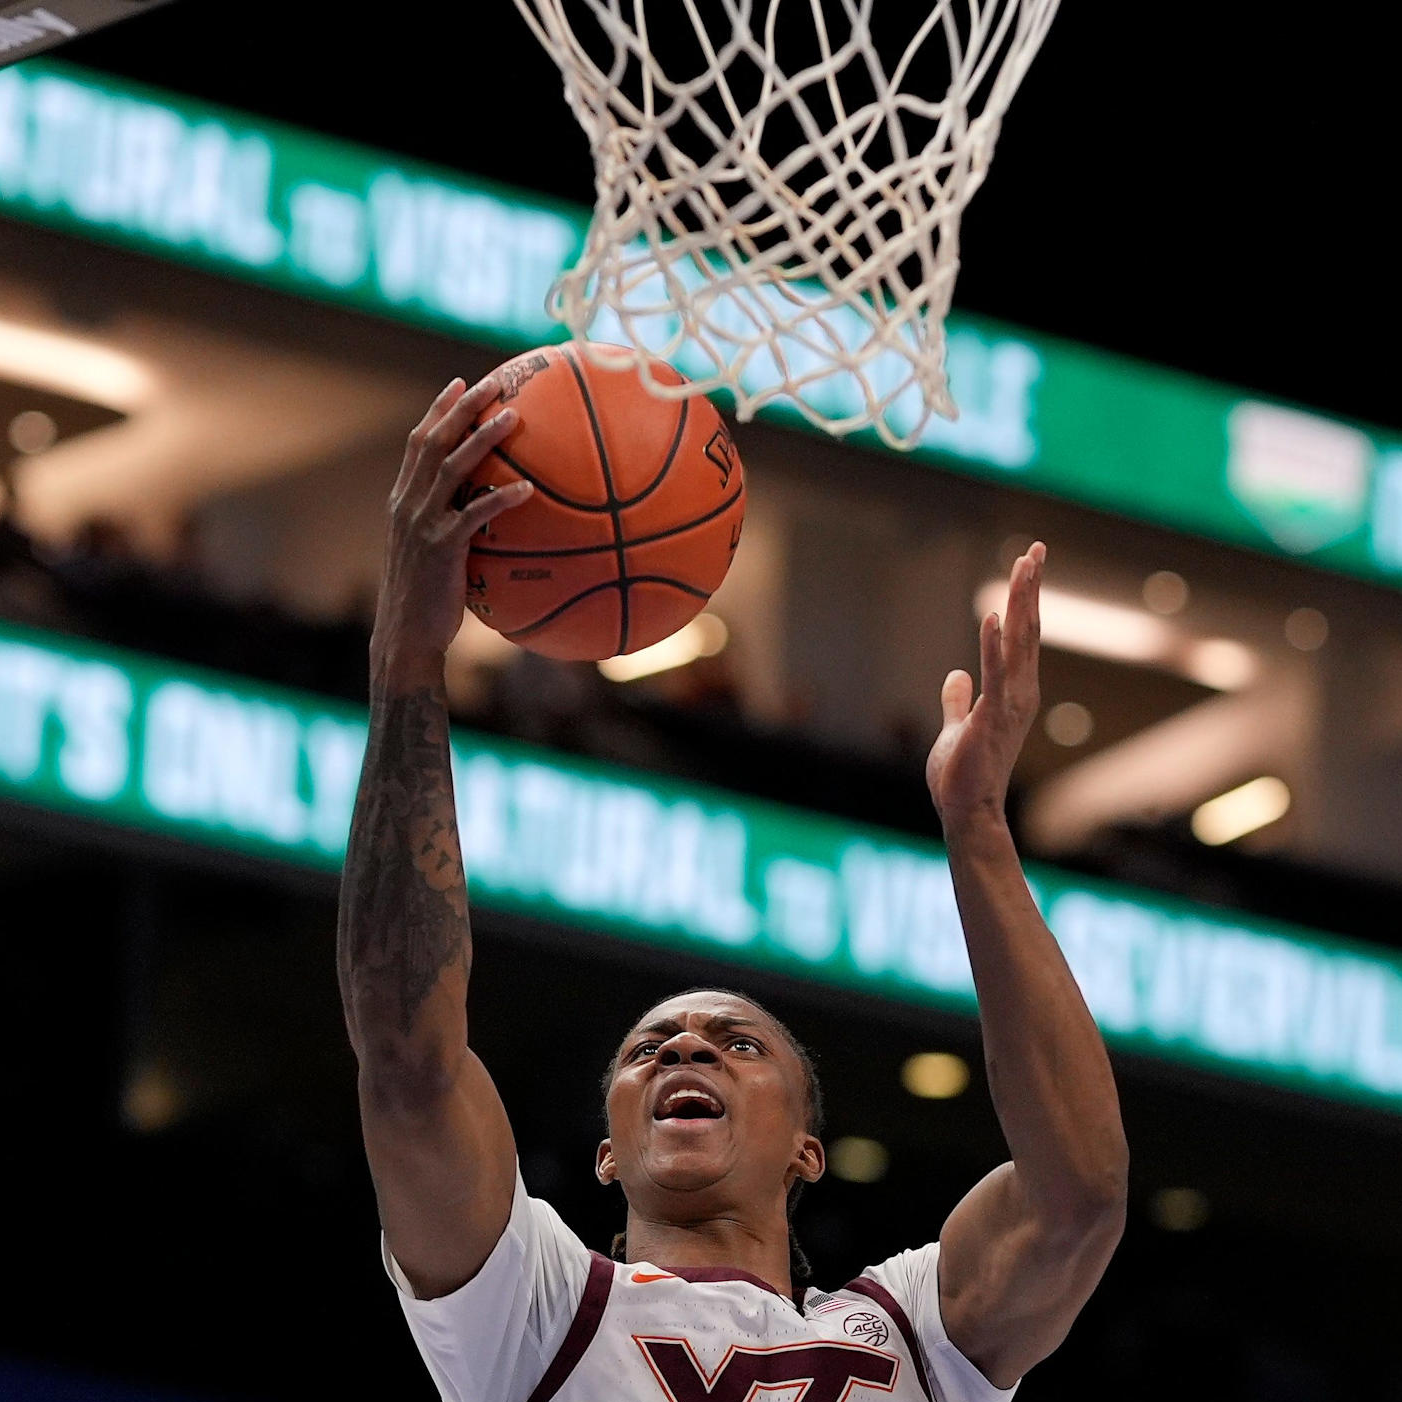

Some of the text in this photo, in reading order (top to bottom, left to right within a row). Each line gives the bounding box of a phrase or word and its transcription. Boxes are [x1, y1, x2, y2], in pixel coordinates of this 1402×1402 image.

[142, 679, 370, 856] ONLY
[450, 745, 758, 946] ATURAL
[850, 1320, 883, 1335] ACC
